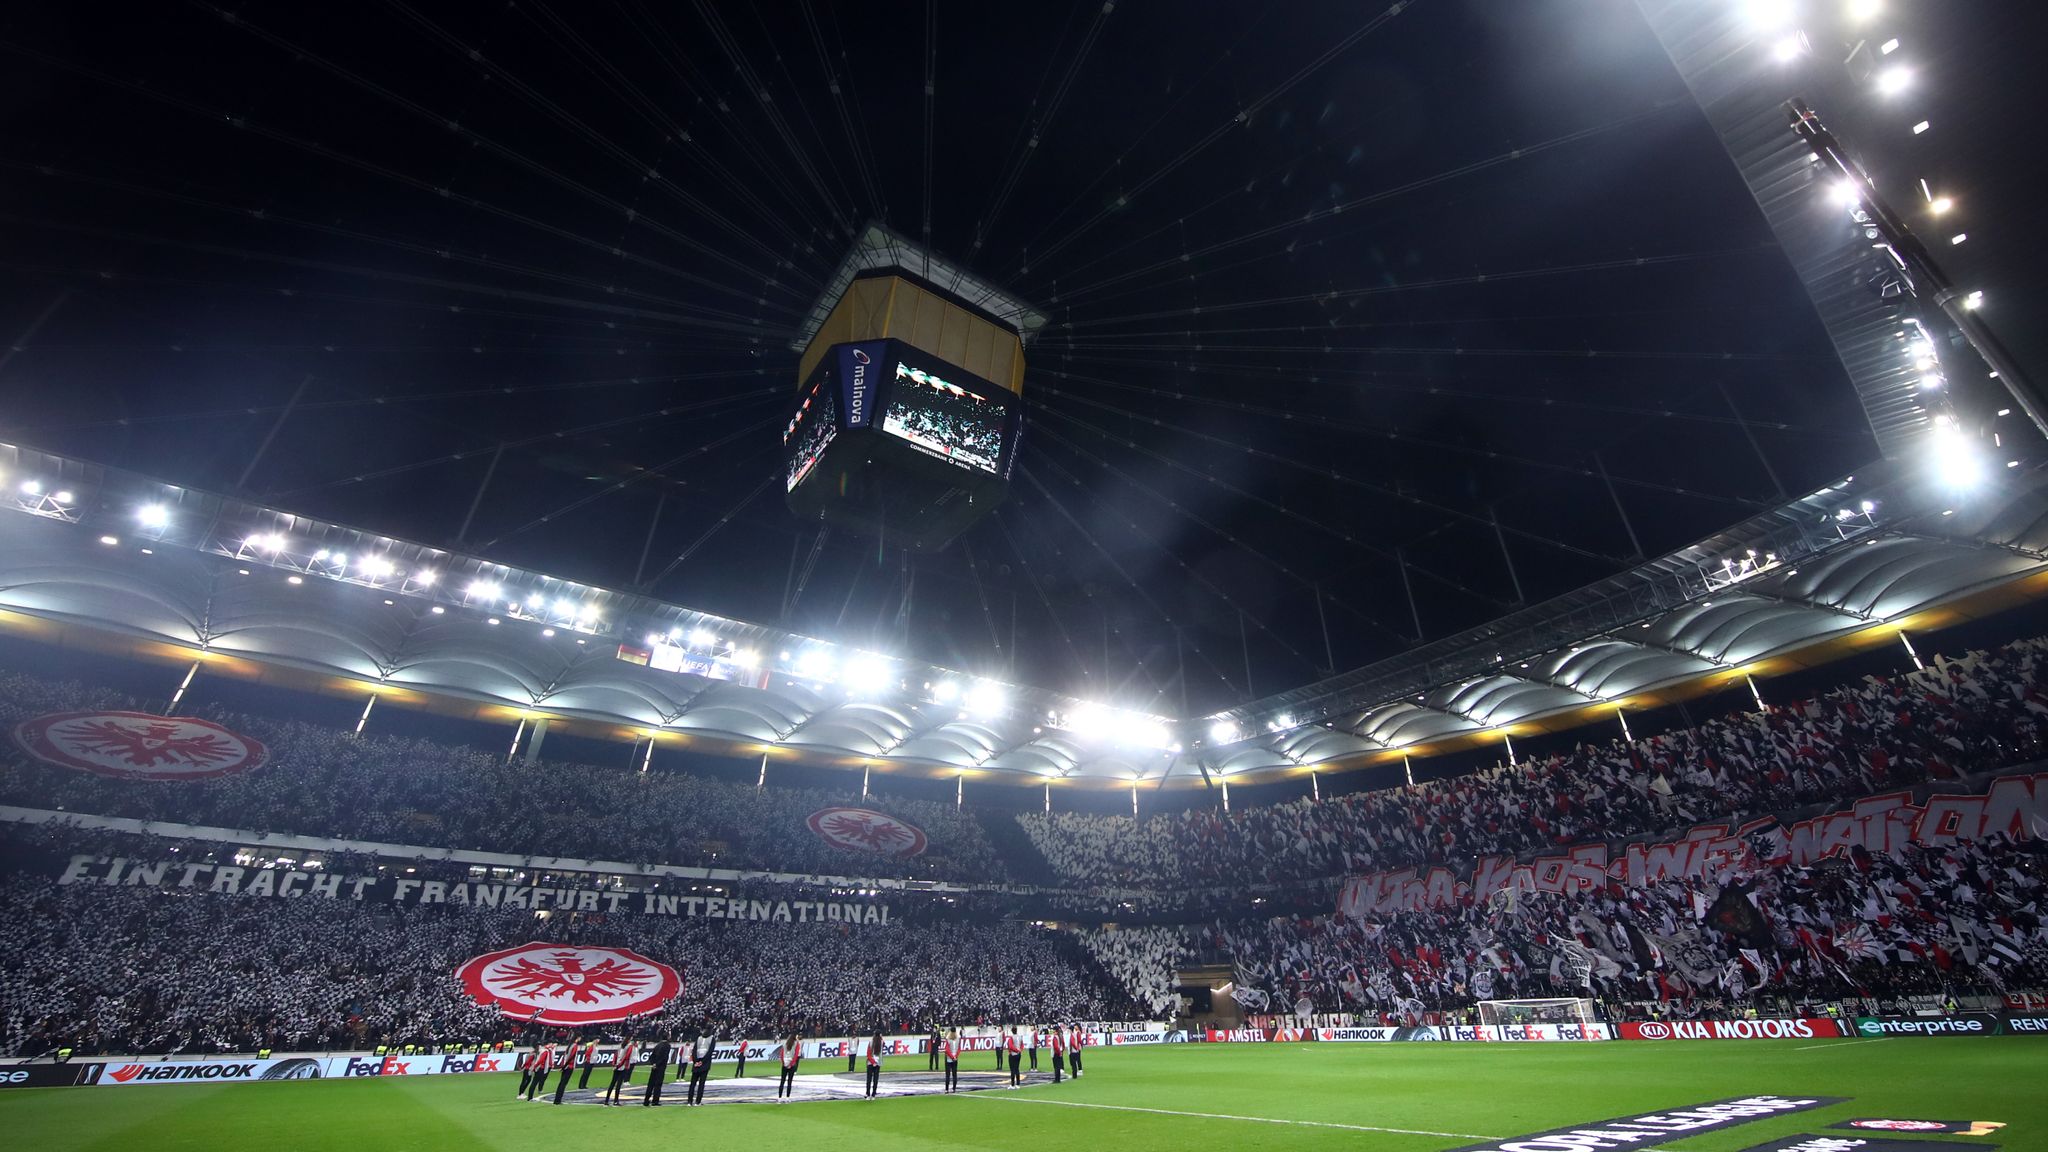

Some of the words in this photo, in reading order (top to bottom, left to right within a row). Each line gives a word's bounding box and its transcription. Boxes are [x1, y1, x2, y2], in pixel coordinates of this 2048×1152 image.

[851, 365, 866, 424] mainova
[1470, 842, 1608, 903] KAOS
[57, 854, 377, 900] EINTRACHT
[393, 879, 629, 914] FRANKFURT
[644, 894, 889, 926] INTERNATIONAL
[1227, 1029, 1267, 1042] AMSTEL
[1504, 1025, 1545, 1040] FedEx
[1556, 1024, 1602, 1040] FedEx
[1644, 1025, 1665, 1036] KIA
[1671, 1021, 1711, 1039] KIA
[1714, 1019, 1813, 1038] MOTORS
[1858, 1018, 1983, 1036] enterprise
[818, 1041, 849, 1058] FedE
[881, 1040, 911, 1055] edEx
[344, 1056, 411, 1077] FedEx
[440, 1054, 501, 1073] FedEx
